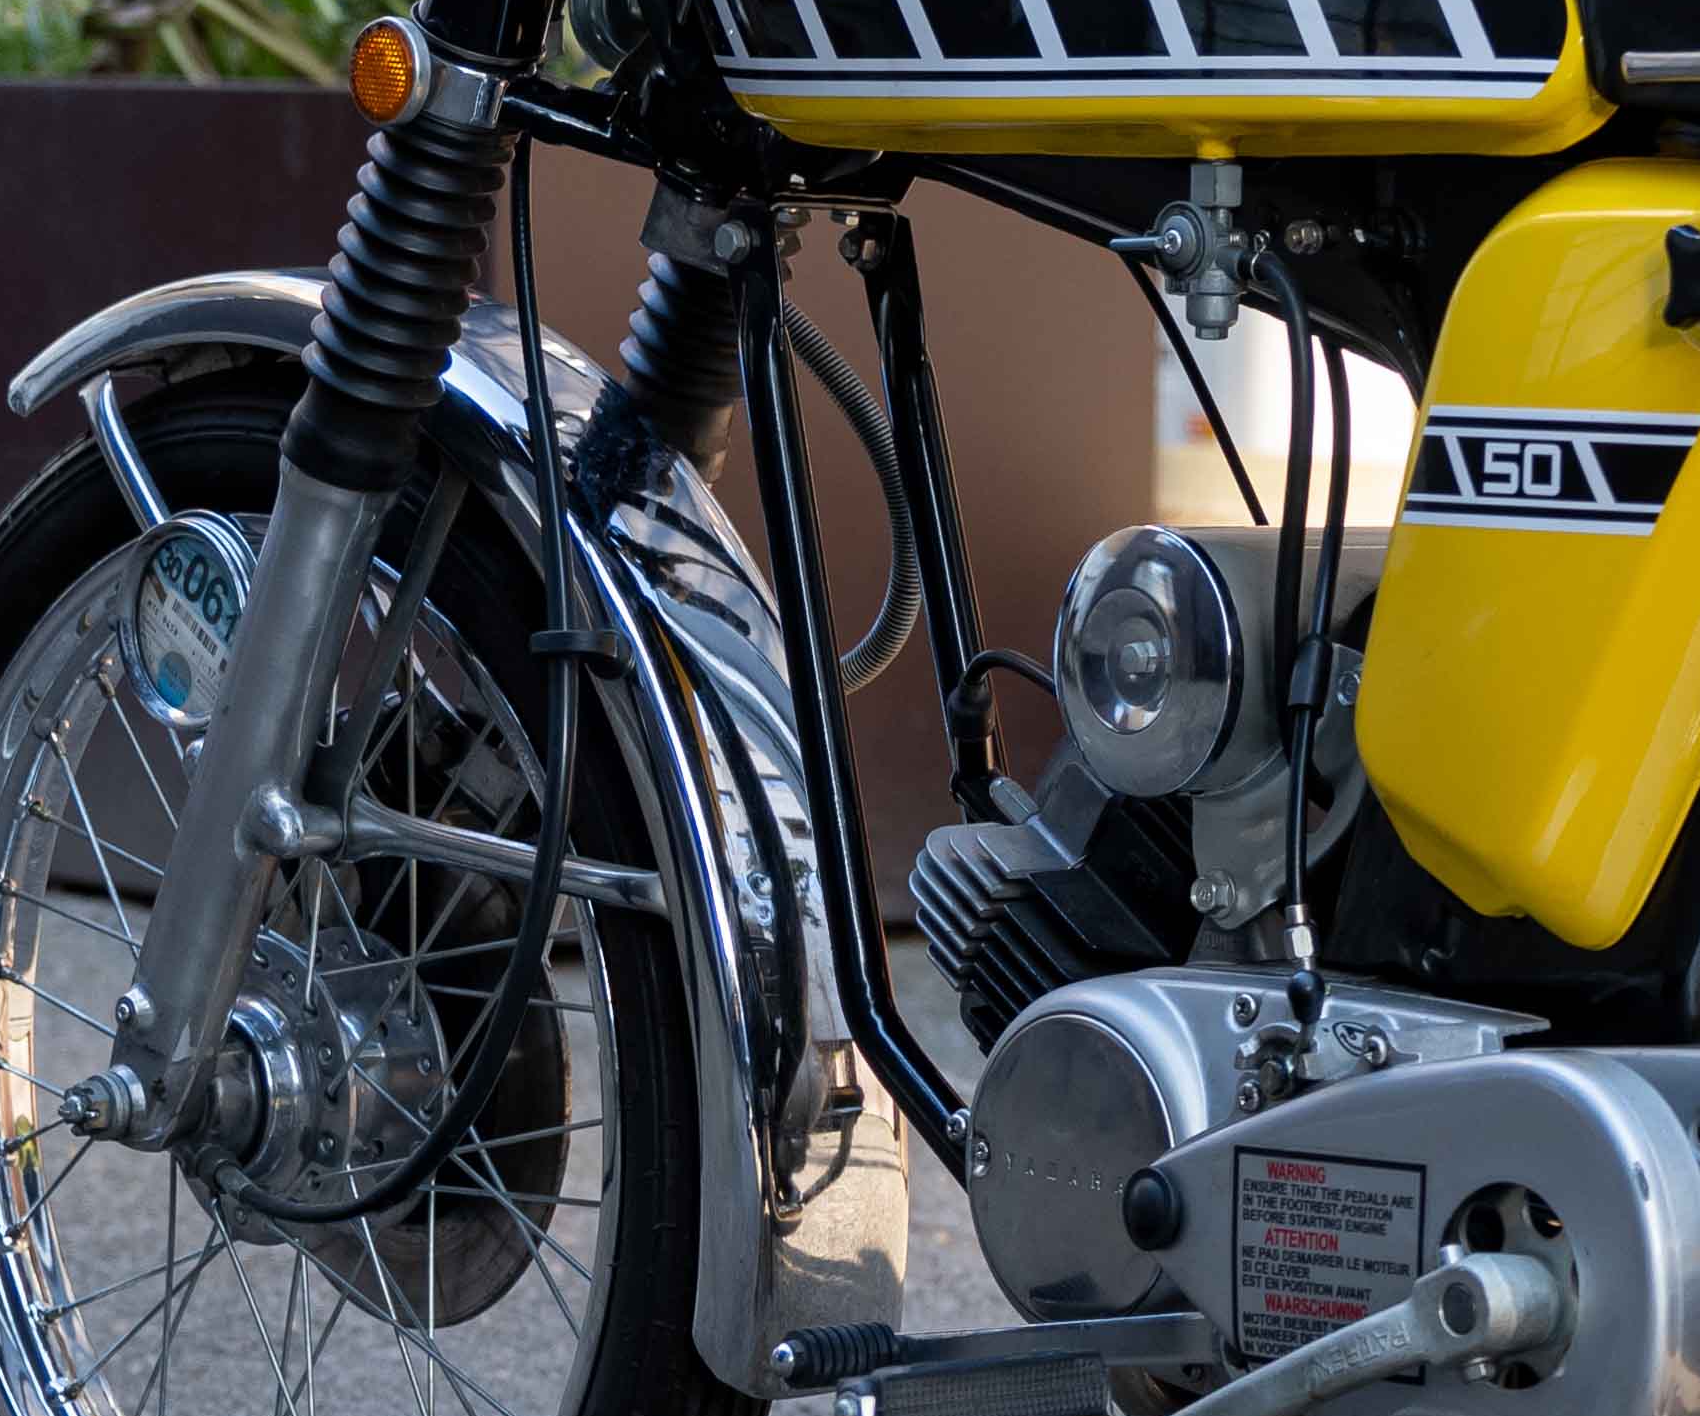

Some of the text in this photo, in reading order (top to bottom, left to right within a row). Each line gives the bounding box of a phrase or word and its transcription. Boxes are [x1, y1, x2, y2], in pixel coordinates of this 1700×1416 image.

[1483, 442, 1562, 497] 50
[1267, 1161, 1325, 1183] WARNING
[1243, 1178, 1414, 1209] ENSURE THAT THE PEDALS ARE
[1243, 1194, 1253, 1205] IN
[1257, 1195, 1277, 1208] THE
[1243, 1208, 1387, 1236] BEFORE STARTING ENGINE
[1264, 1227, 1339, 1252] ATTENTION
[1242, 1260, 1311, 1280] SI CE LEVIER
[1243, 1246, 1255, 1259] NE
[1259, 1247, 1279, 1262] PAS
[1347, 1258, 1360, 1271] LE
[1363, 1260, 1410, 1276] MOTEUR
[1242, 1274, 1372, 1301] EST EN POSITION AVANT
[1243, 1311, 1281, 1326] MOTOR
